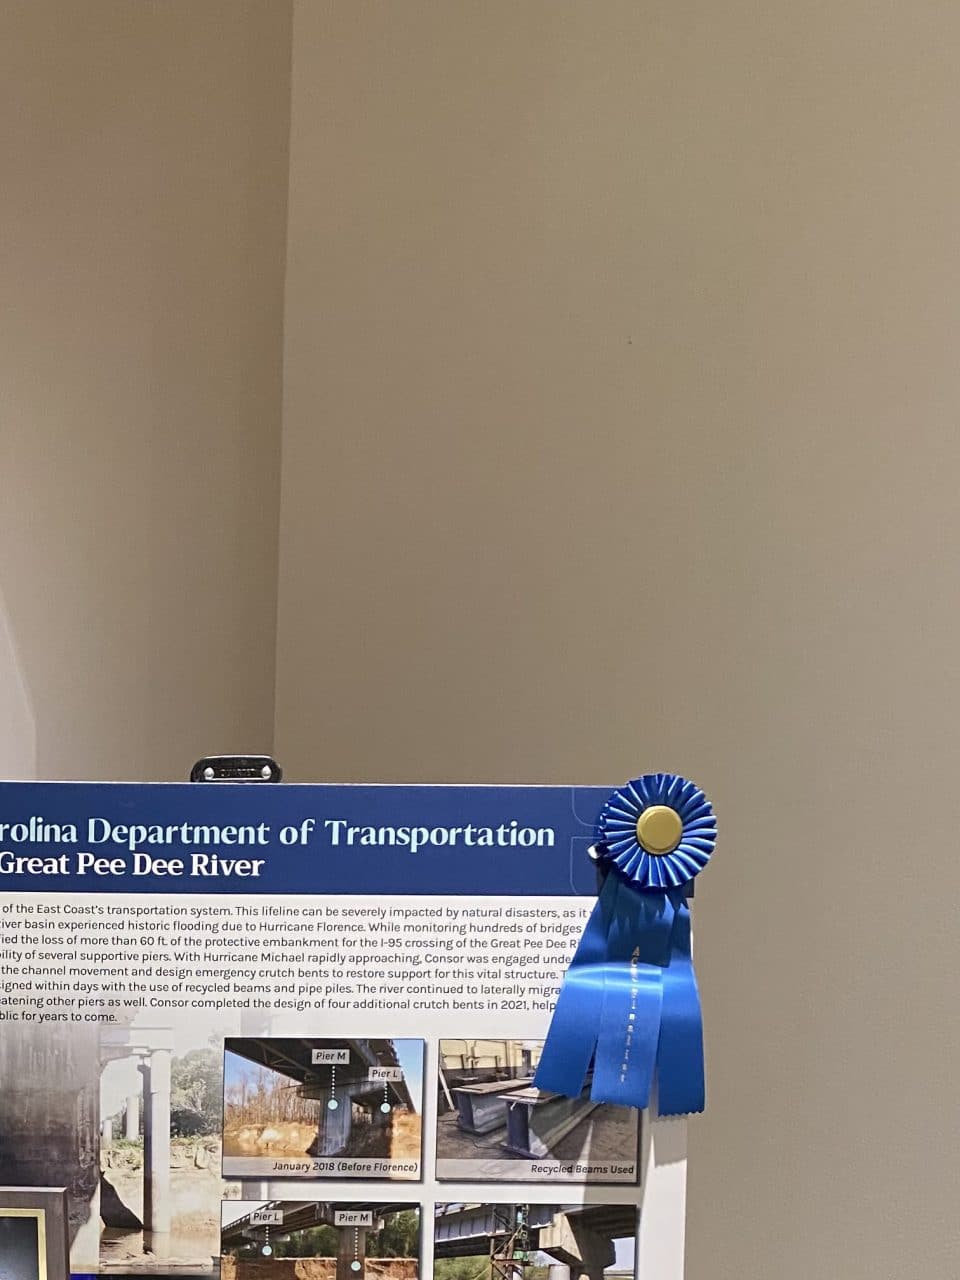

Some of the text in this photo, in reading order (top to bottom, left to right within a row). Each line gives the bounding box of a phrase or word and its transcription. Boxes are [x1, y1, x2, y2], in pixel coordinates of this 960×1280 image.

[87, 817, 270, 850] Department
[279, 818, 315, 845] of
[324, 818, 554, 852] Transportation
[76, 852, 126, 875] Pee
[132, 853, 184, 876] Dee
[190, 853, 265, 877] River
[1, 903, 13, 913] of
[15, 903, 33, 913] the
[36, 904, 61, 914] East
[63, 904, 104, 914] Coast's
[106, 904, 187, 918] transportation
[190, 906, 233, 919] system.
[234, 905, 258, 916] This
[261, 905, 299, 916] lifeline
[301, 908, 322, 916] can
[325, 906, 339, 916] be
[341, 906, 386, 920] severely
[389, 906, 442, 920] impacted
[445, 906, 459, 920] by
[461, 907, 502, 917] natural
[504, 907, 560, 918] disasters,
[562, 910, 576, 918] as
[578, 907, 587, 918] it
[21, 1010, 36, 1021] for
[38, 1013, 68, 1024] years
[70, 1012, 81, 1021] to
[84, 1013, 118, 1022] come.
[315, 1051, 335, 1060] Pier
[372, 1069, 391, 1078] Pier
[272, 1161, 418, 1173] January 2018 (Before Florence)
[531, 1164, 634, 1175] Recycled Beams Used
[253, 1213, 272, 1221] Pier
[339, 1213, 357, 1222] Pier
